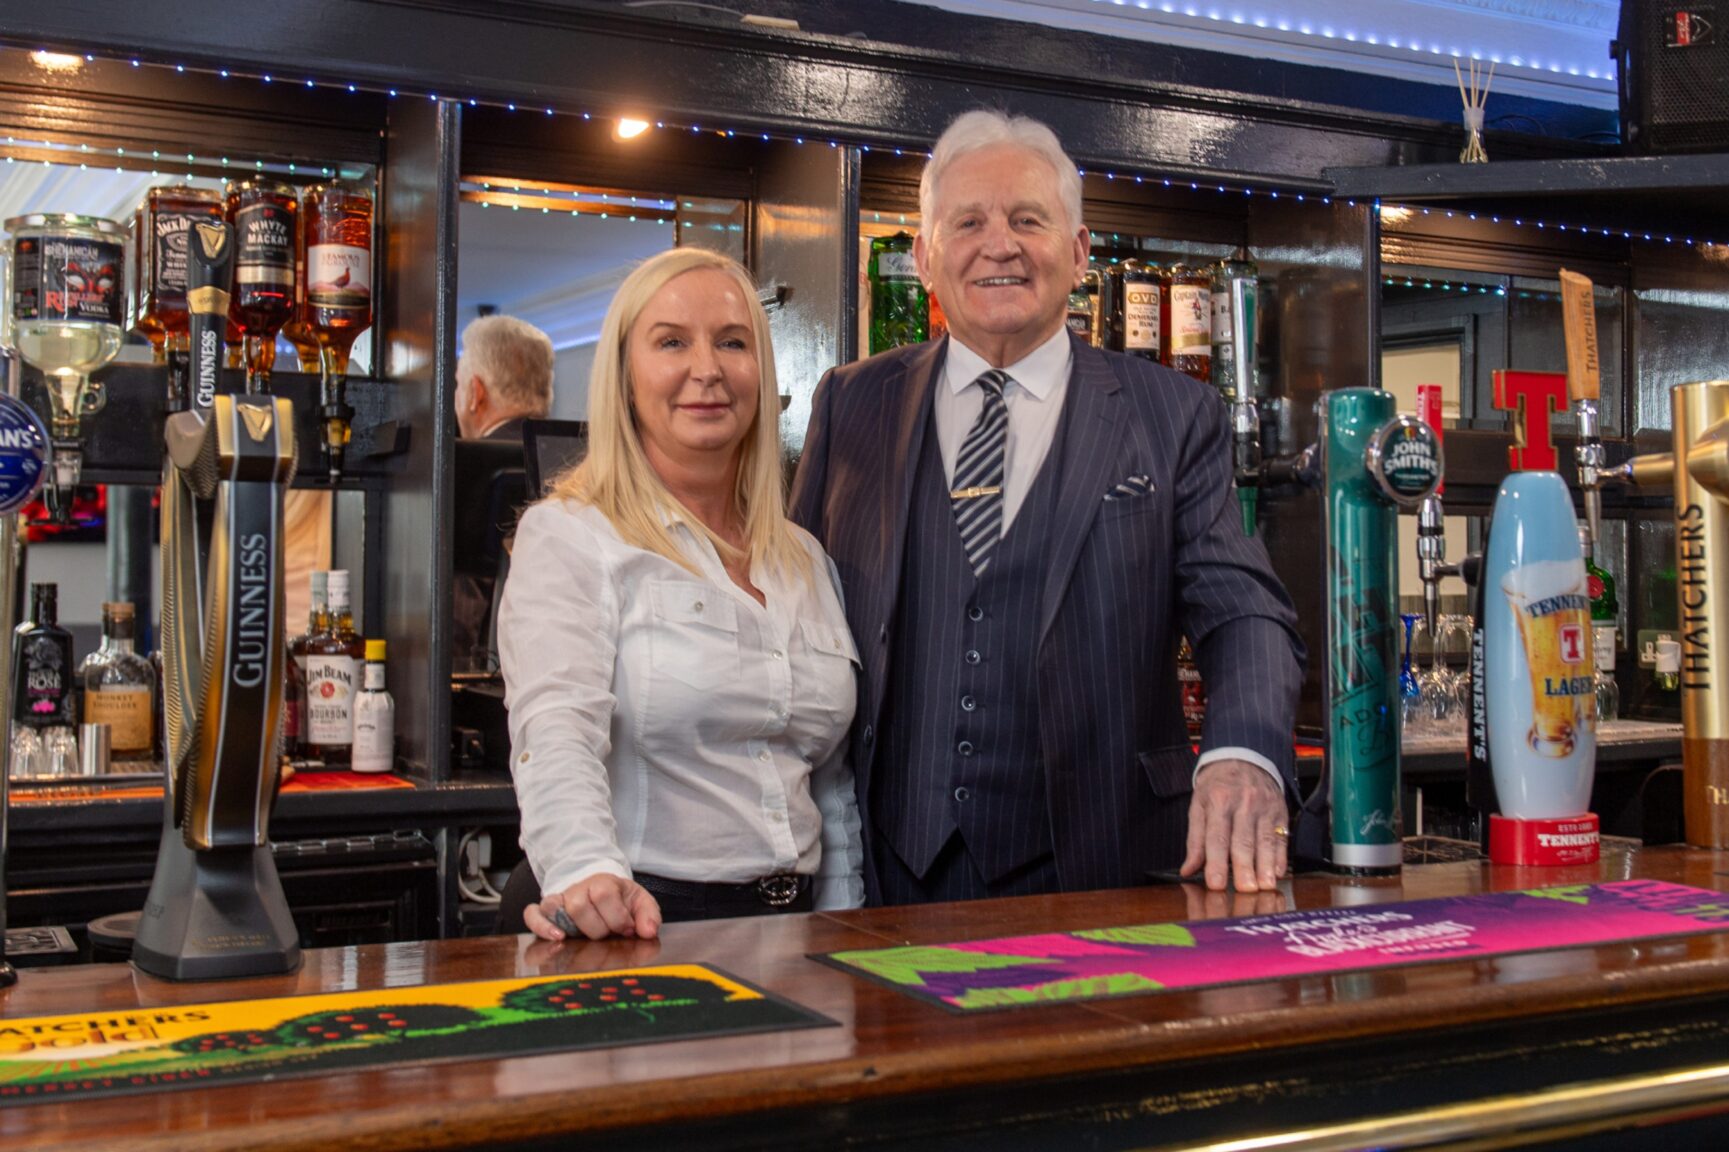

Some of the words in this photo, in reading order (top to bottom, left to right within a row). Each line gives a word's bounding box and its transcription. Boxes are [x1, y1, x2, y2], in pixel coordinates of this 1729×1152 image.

[248, 219, 287, 235] WHYTE
[247, 233, 288, 246] MACKAY
[1131, 292, 1158, 304] OVD
[1581, 291, 1598, 373] THATCHERS
[197, 330, 217, 407] GUINNESS
[1391, 441, 1431, 459] JOHN
[1384, 455, 1438, 476] SMITH'S
[1677, 503, 1711, 690] THATCHERS
[233, 532, 267, 688] GUINNESS
[307, 668, 322, 685] JIM
[324, 665, 352, 685] BEAM
[1473, 628, 1487, 762] TENNENT'S
[309, 708, 348, 720] BOURBON
